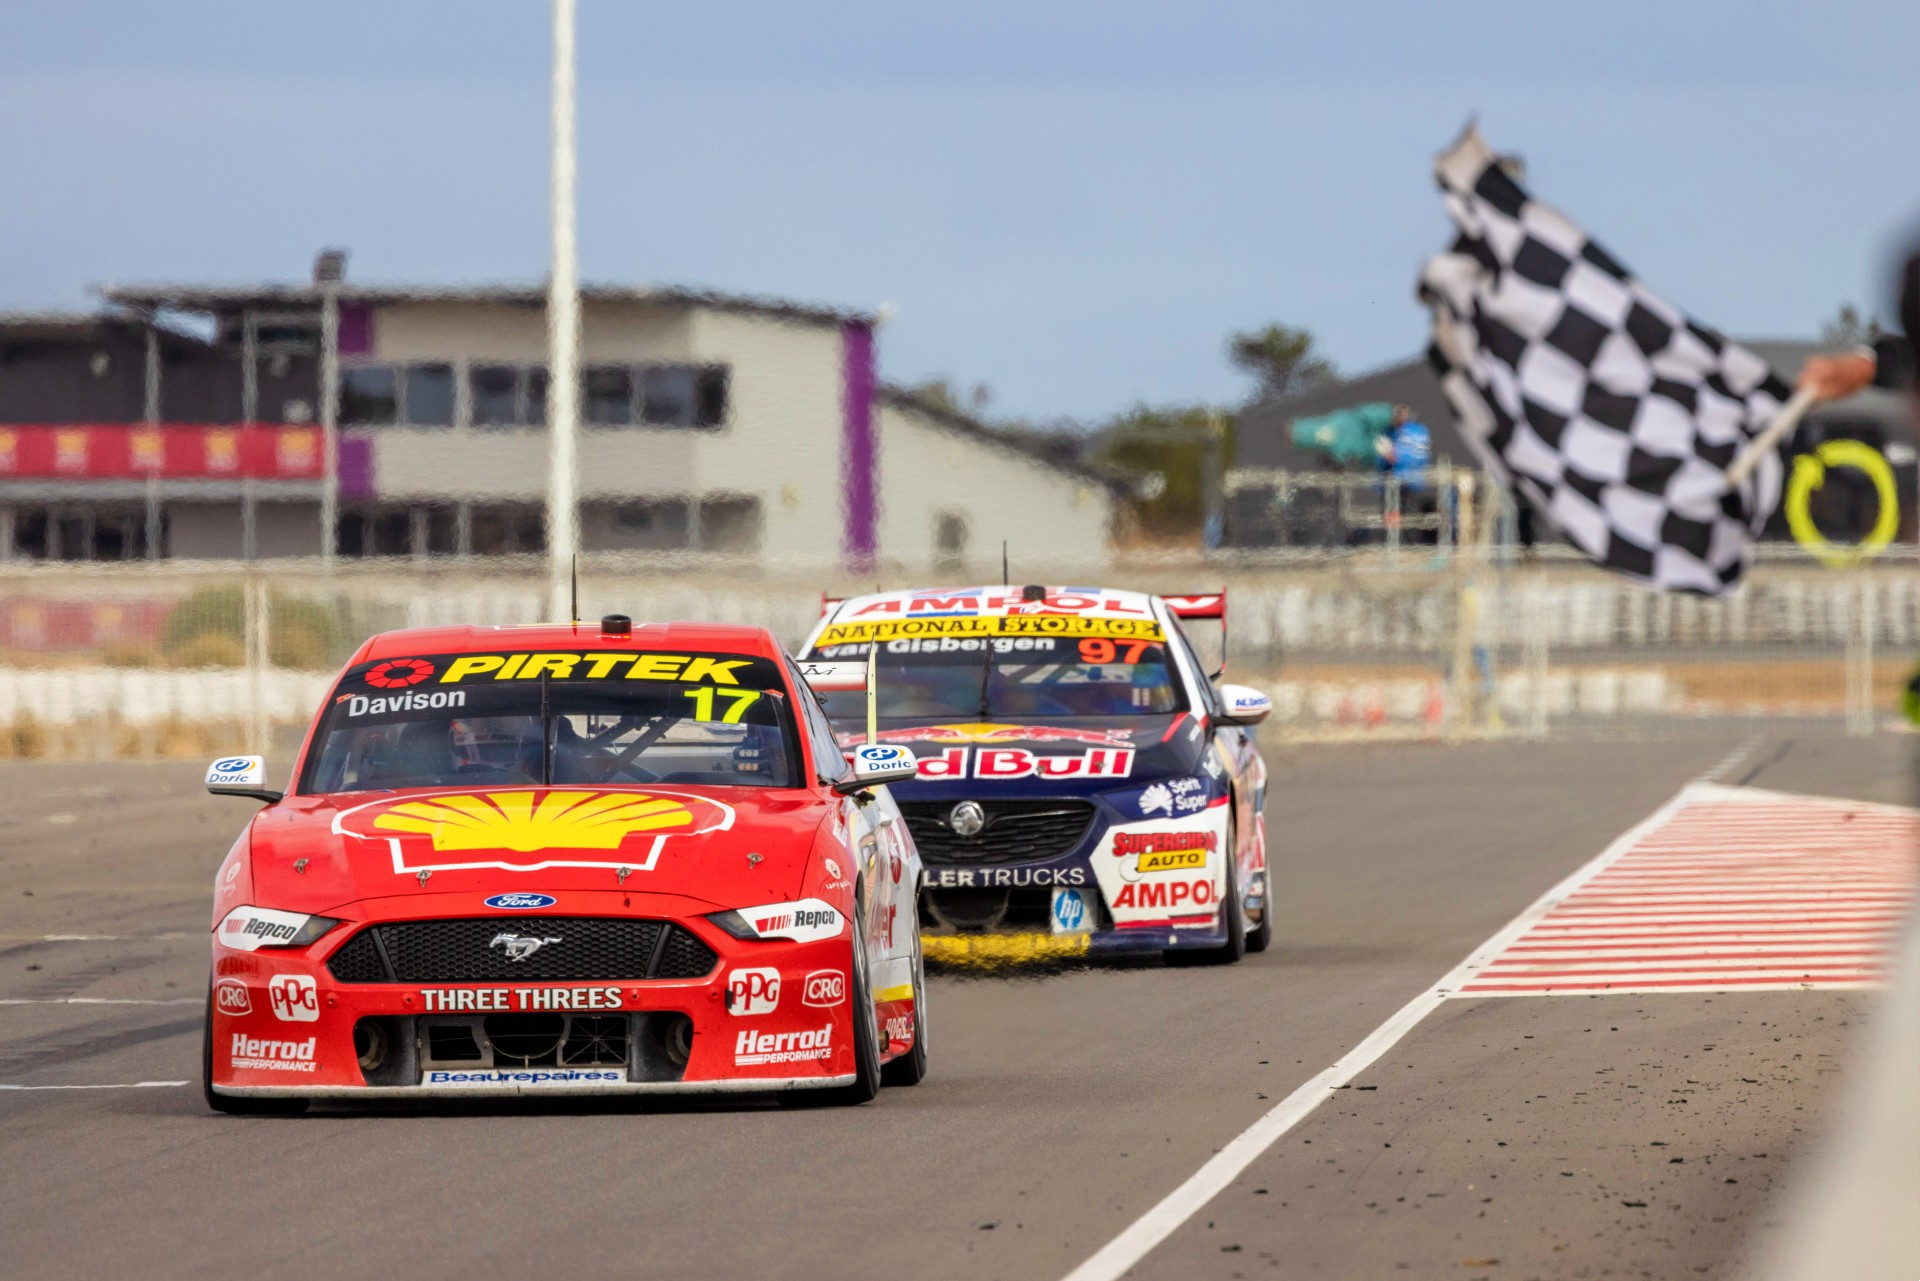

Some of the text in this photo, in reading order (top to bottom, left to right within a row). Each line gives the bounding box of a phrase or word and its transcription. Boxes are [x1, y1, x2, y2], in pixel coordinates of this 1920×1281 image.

[850, 596, 1146, 617] AMPOL
[827, 617, 1161, 640] NATIONAL STORAGE
[887, 635, 1056, 654] Gisbergen
[1078, 637, 1150, 665] 97
[439, 653, 754, 685] PIRTEK
[349, 690, 466, 717] Davison
[684, 686, 761, 724] 17
[869, 760, 912, 771] Doric
[975, 749, 1135, 778] Bull
[208, 773, 250, 784] Doric
[1169, 777, 1202, 795] Spirit
[1175, 794, 1207, 811] Super
[1147, 853, 1200, 867] AUTO
[980, 867, 1085, 887] TRUCKS
[497, 894, 543, 908] Ford
[1112, 880, 1218, 908] AMPOL
[795, 909, 836, 930] Repco
[1058, 889, 1084, 928] hp
[243, 918, 298, 940] Repco
[219, 986, 247, 1008] CRC
[272, 976, 318, 1018] PPG
[732, 972, 780, 1013] PPG
[807, 977, 844, 998] CRC
[420, 987, 623, 1011] THREE THREES
[232, 1033, 316, 1060] Herrod
[735, 1024, 832, 1054] Herrod
[250, 1059, 317, 1072] PERFORMANCE
[763, 1048, 832, 1064] PERFORMANCE
[430, 1070, 619, 1083] Beaurepaires
